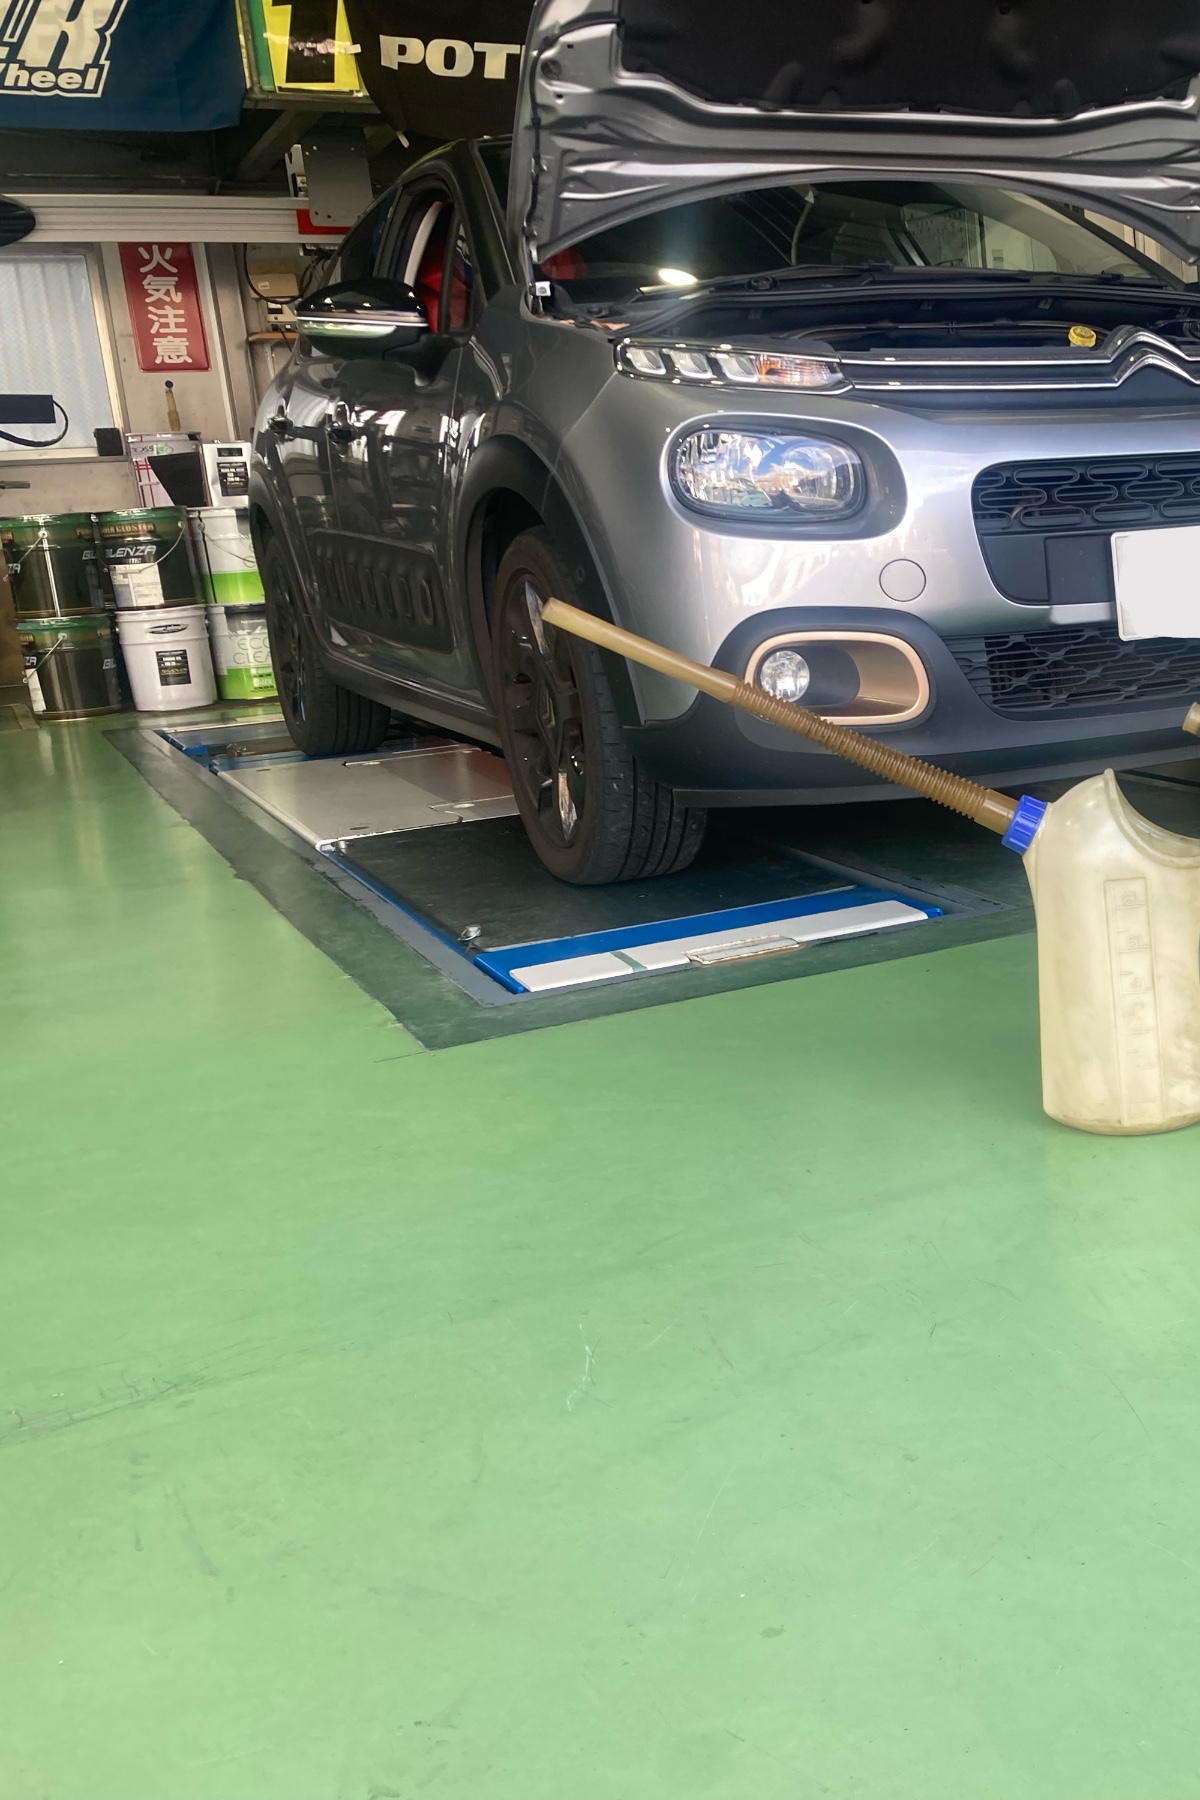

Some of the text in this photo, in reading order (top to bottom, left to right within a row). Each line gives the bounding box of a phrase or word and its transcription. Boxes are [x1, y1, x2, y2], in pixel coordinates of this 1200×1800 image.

[0, 63, 99, 90] heel
[379, 34, 525, 80] POT
[138, 244, 193, 364] 火気注意
